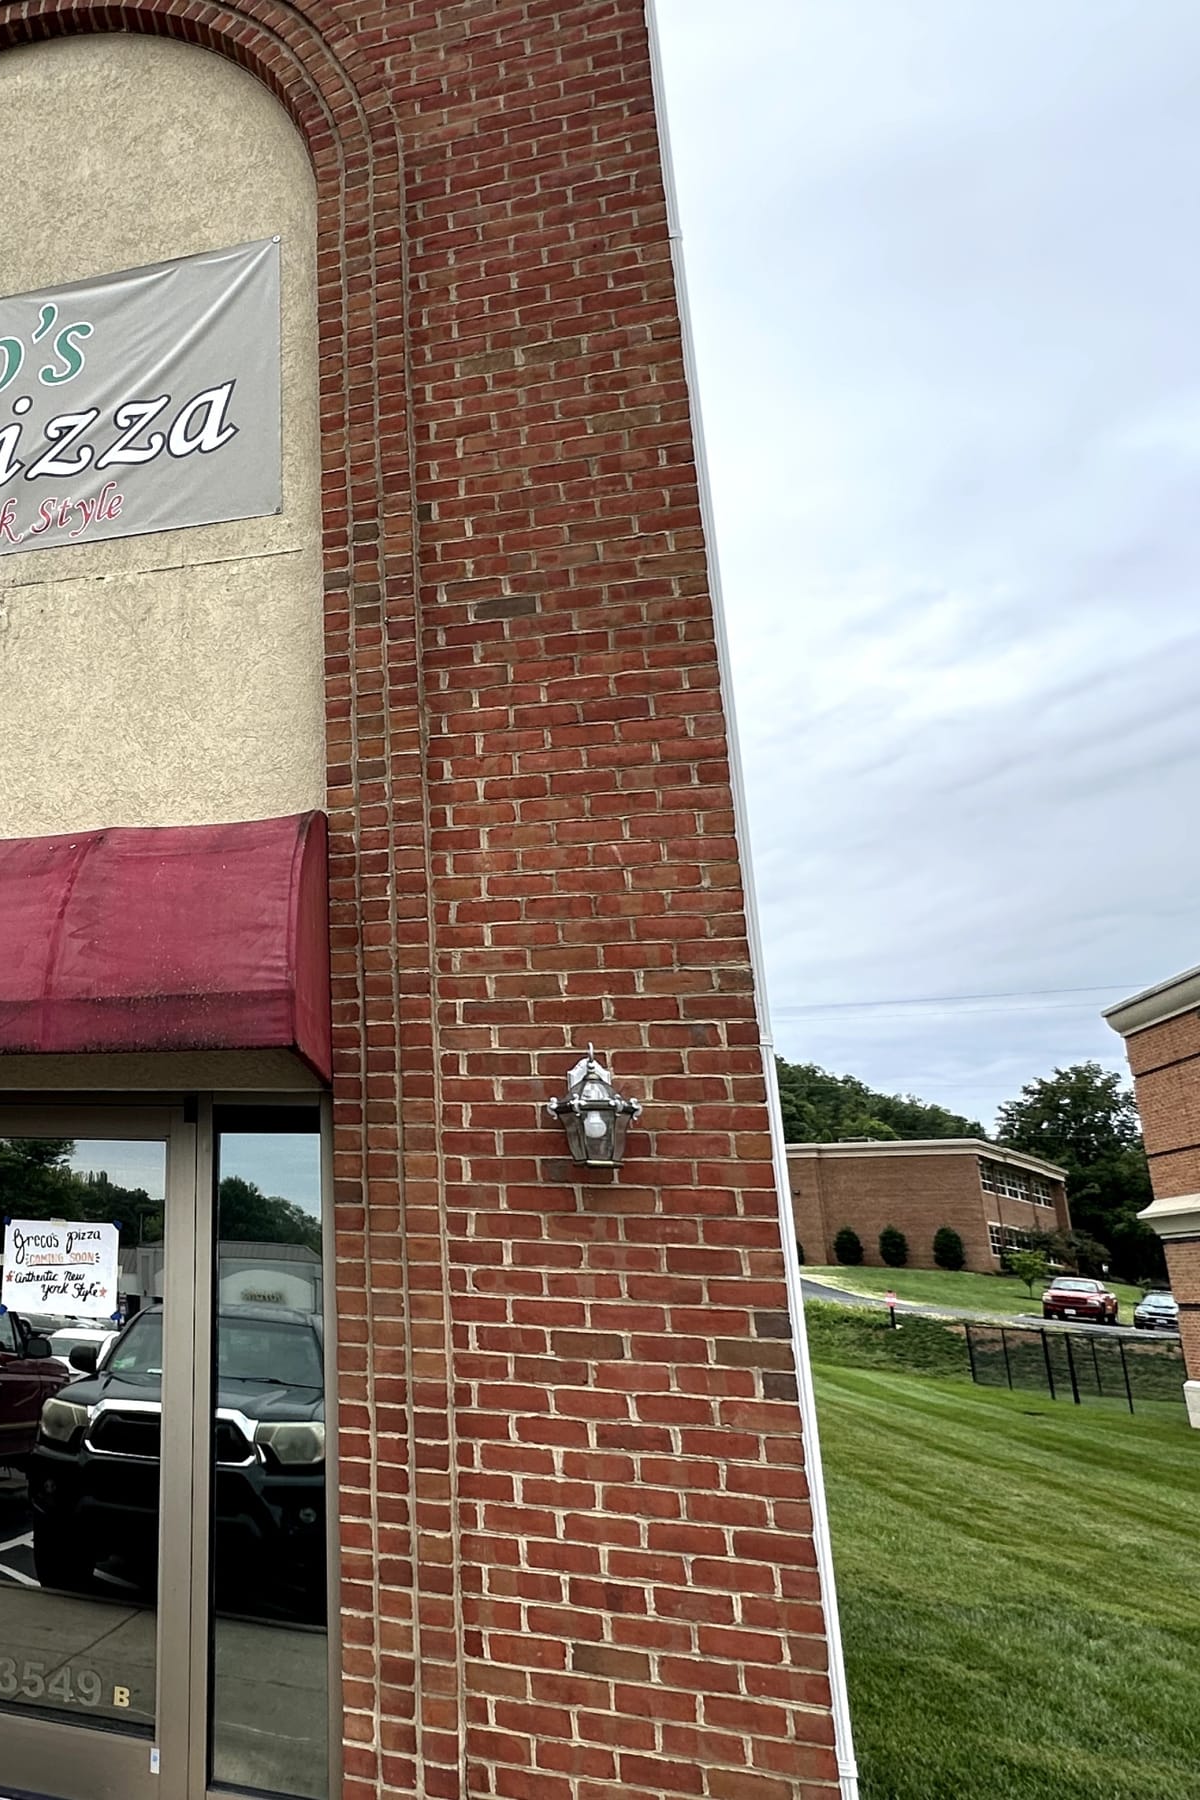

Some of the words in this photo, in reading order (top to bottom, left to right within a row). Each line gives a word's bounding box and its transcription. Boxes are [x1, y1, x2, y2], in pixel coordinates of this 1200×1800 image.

[30, 482, 125, 538] Style
[13, 1228, 59, 1264] Greco's
[66, 1230, 101, 1254] pizza
[30, 1253, 64, 1264] COMING
[70, 1252, 94, 1263] SOON
[113, 1686, 130, 1707] B
